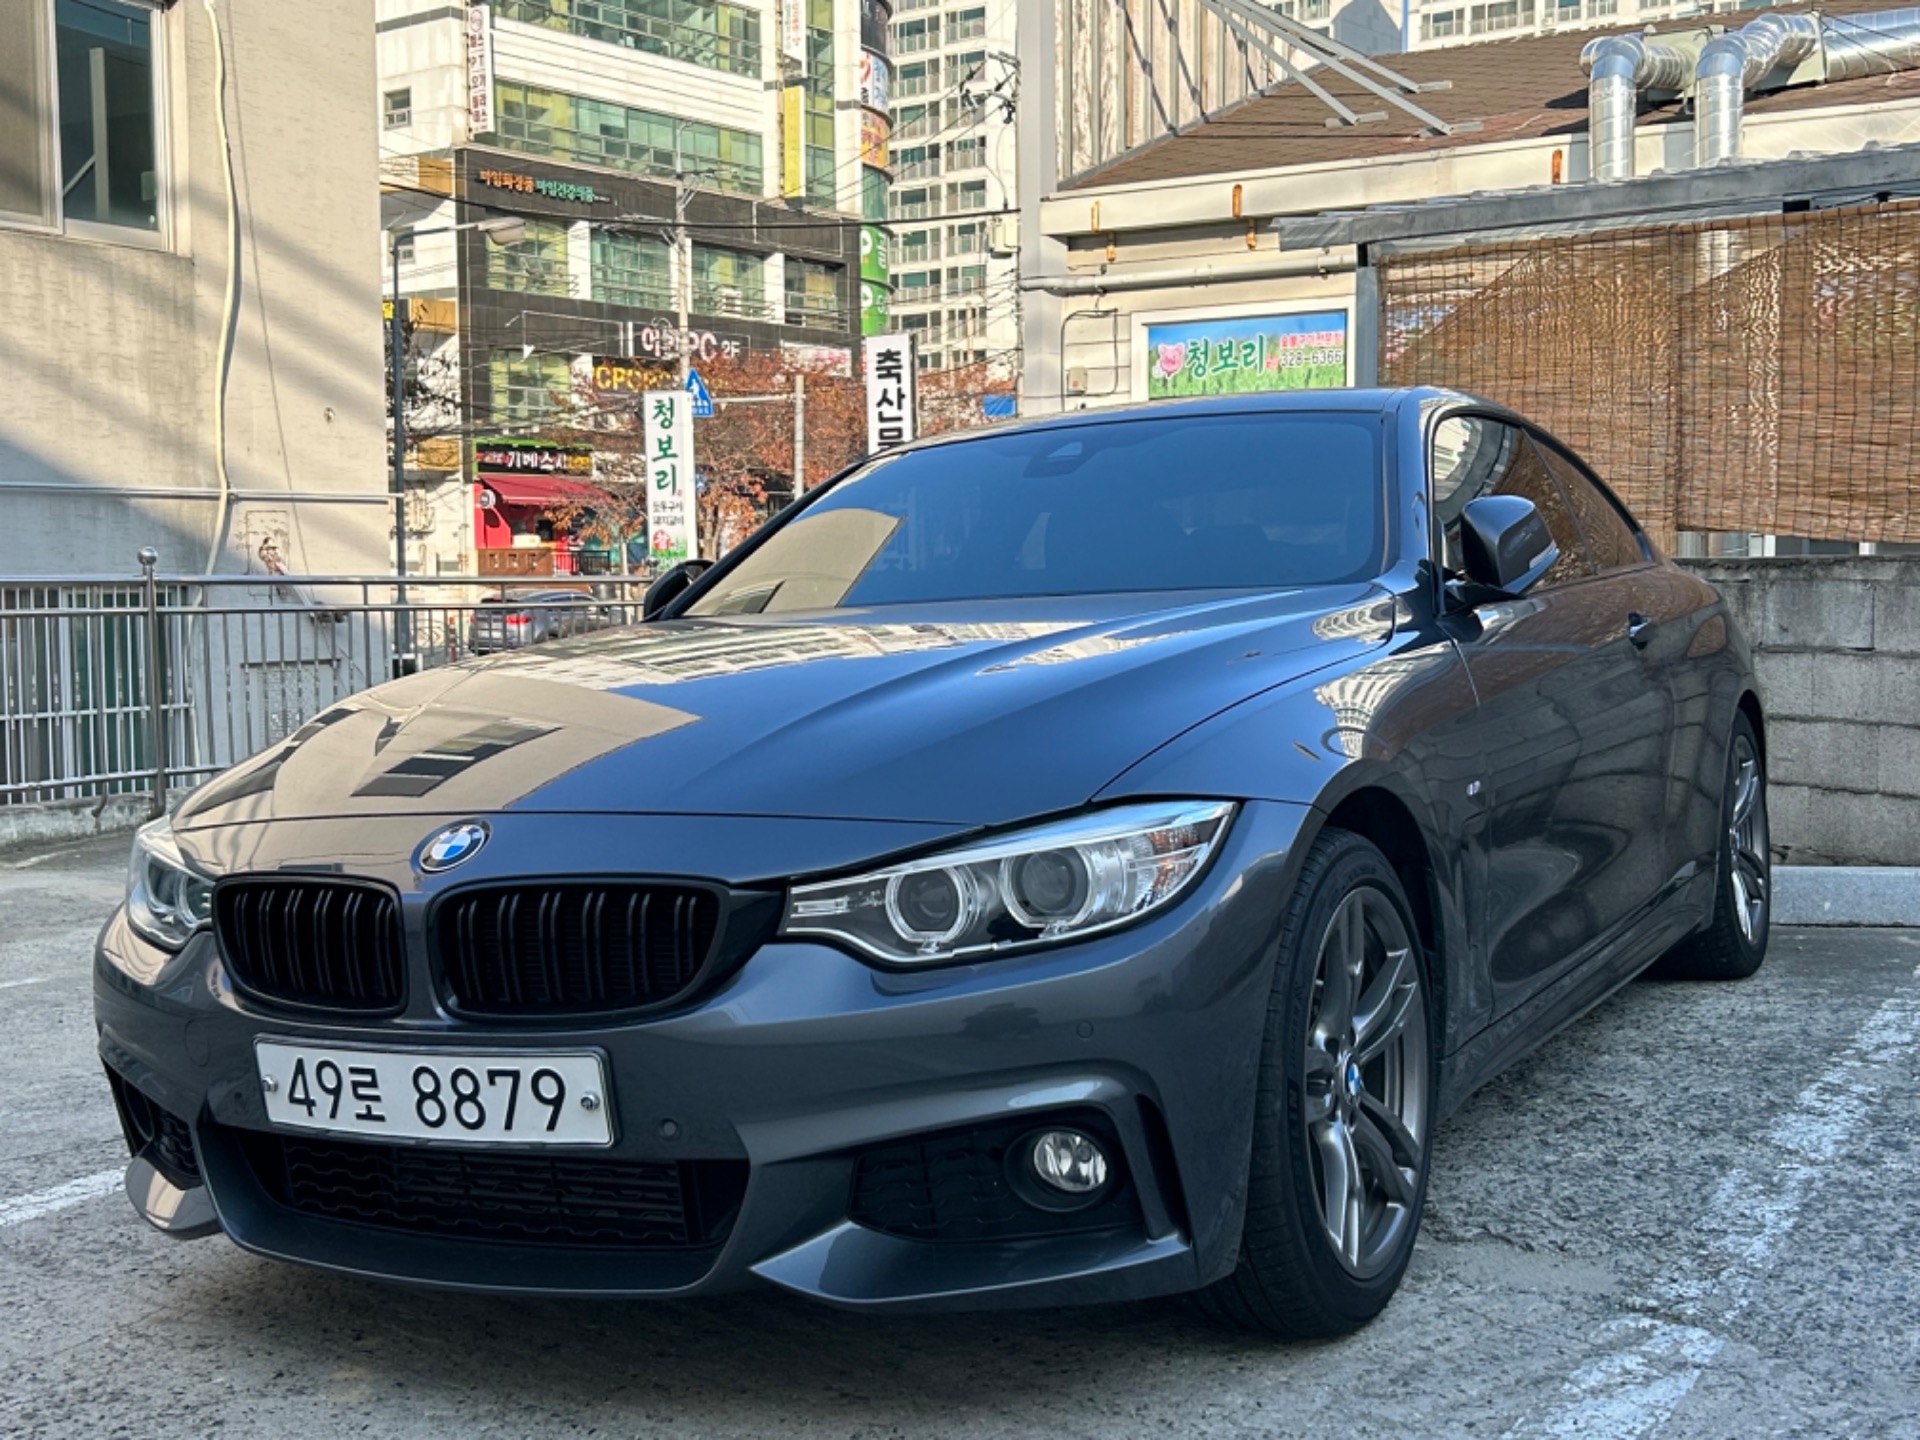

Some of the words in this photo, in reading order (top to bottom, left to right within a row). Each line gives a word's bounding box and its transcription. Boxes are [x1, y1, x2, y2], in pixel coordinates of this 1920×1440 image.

[1187, 335, 1264, 377] 청보리
[1281, 350, 1342, 367] 328-6366
[652, 397, 678, 496] 청보리
[287, 1057, 386, 1123] 49로
[411, 1066, 566, 1132] 8879
